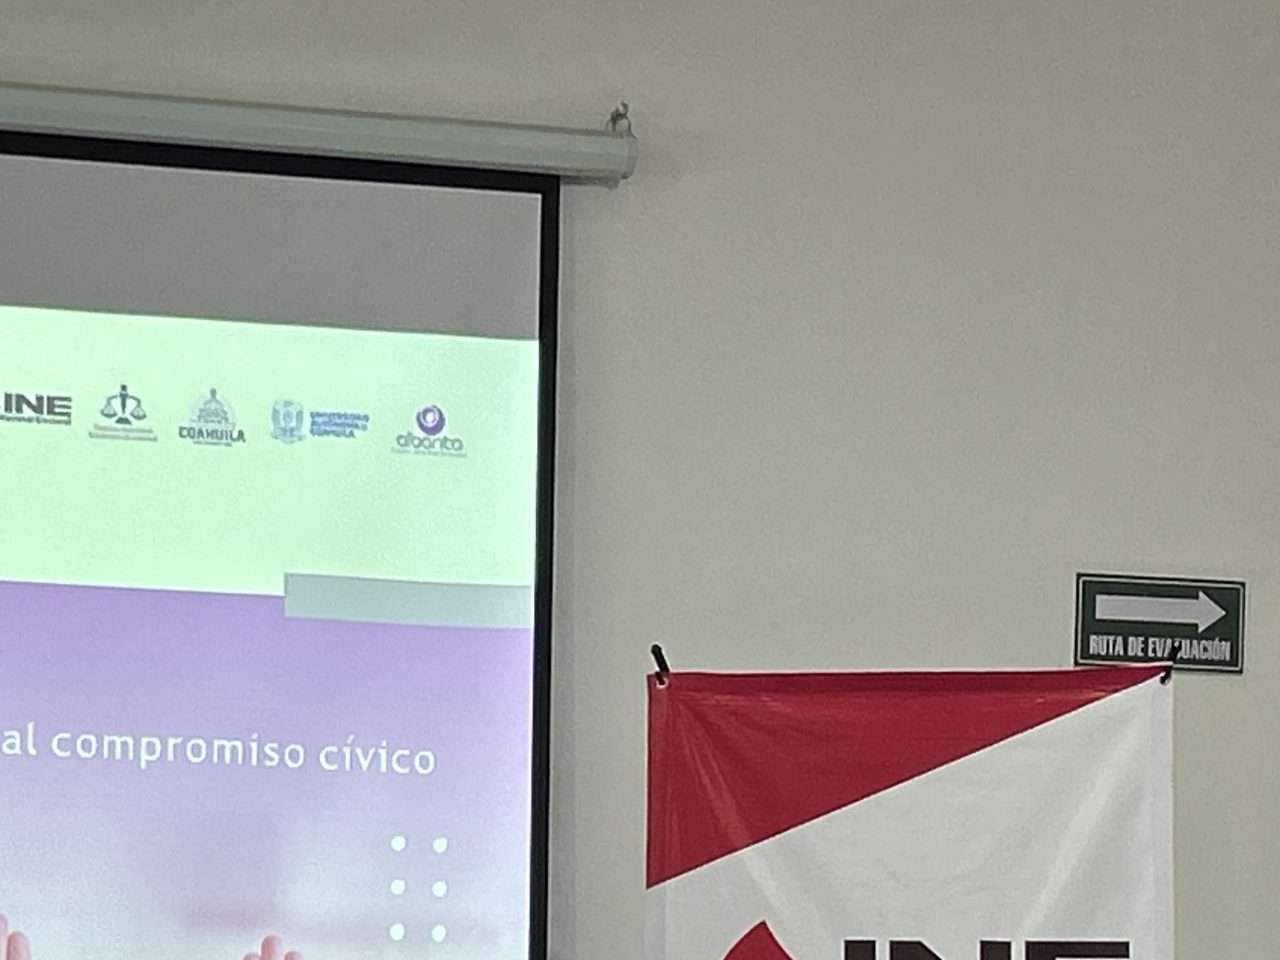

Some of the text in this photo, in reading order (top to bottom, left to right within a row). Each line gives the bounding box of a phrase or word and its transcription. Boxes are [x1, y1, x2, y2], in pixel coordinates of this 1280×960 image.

[4, 392, 72, 417] INE
[178, 425, 246, 443] COAHUILA
[1089, 635, 1124, 656] RUTA
[1128, 636, 1145, 656] DE
[2, 722, 36, 756] al
[51, 731, 305, 770] compromiso
[319, 735, 437, 775] cívico
